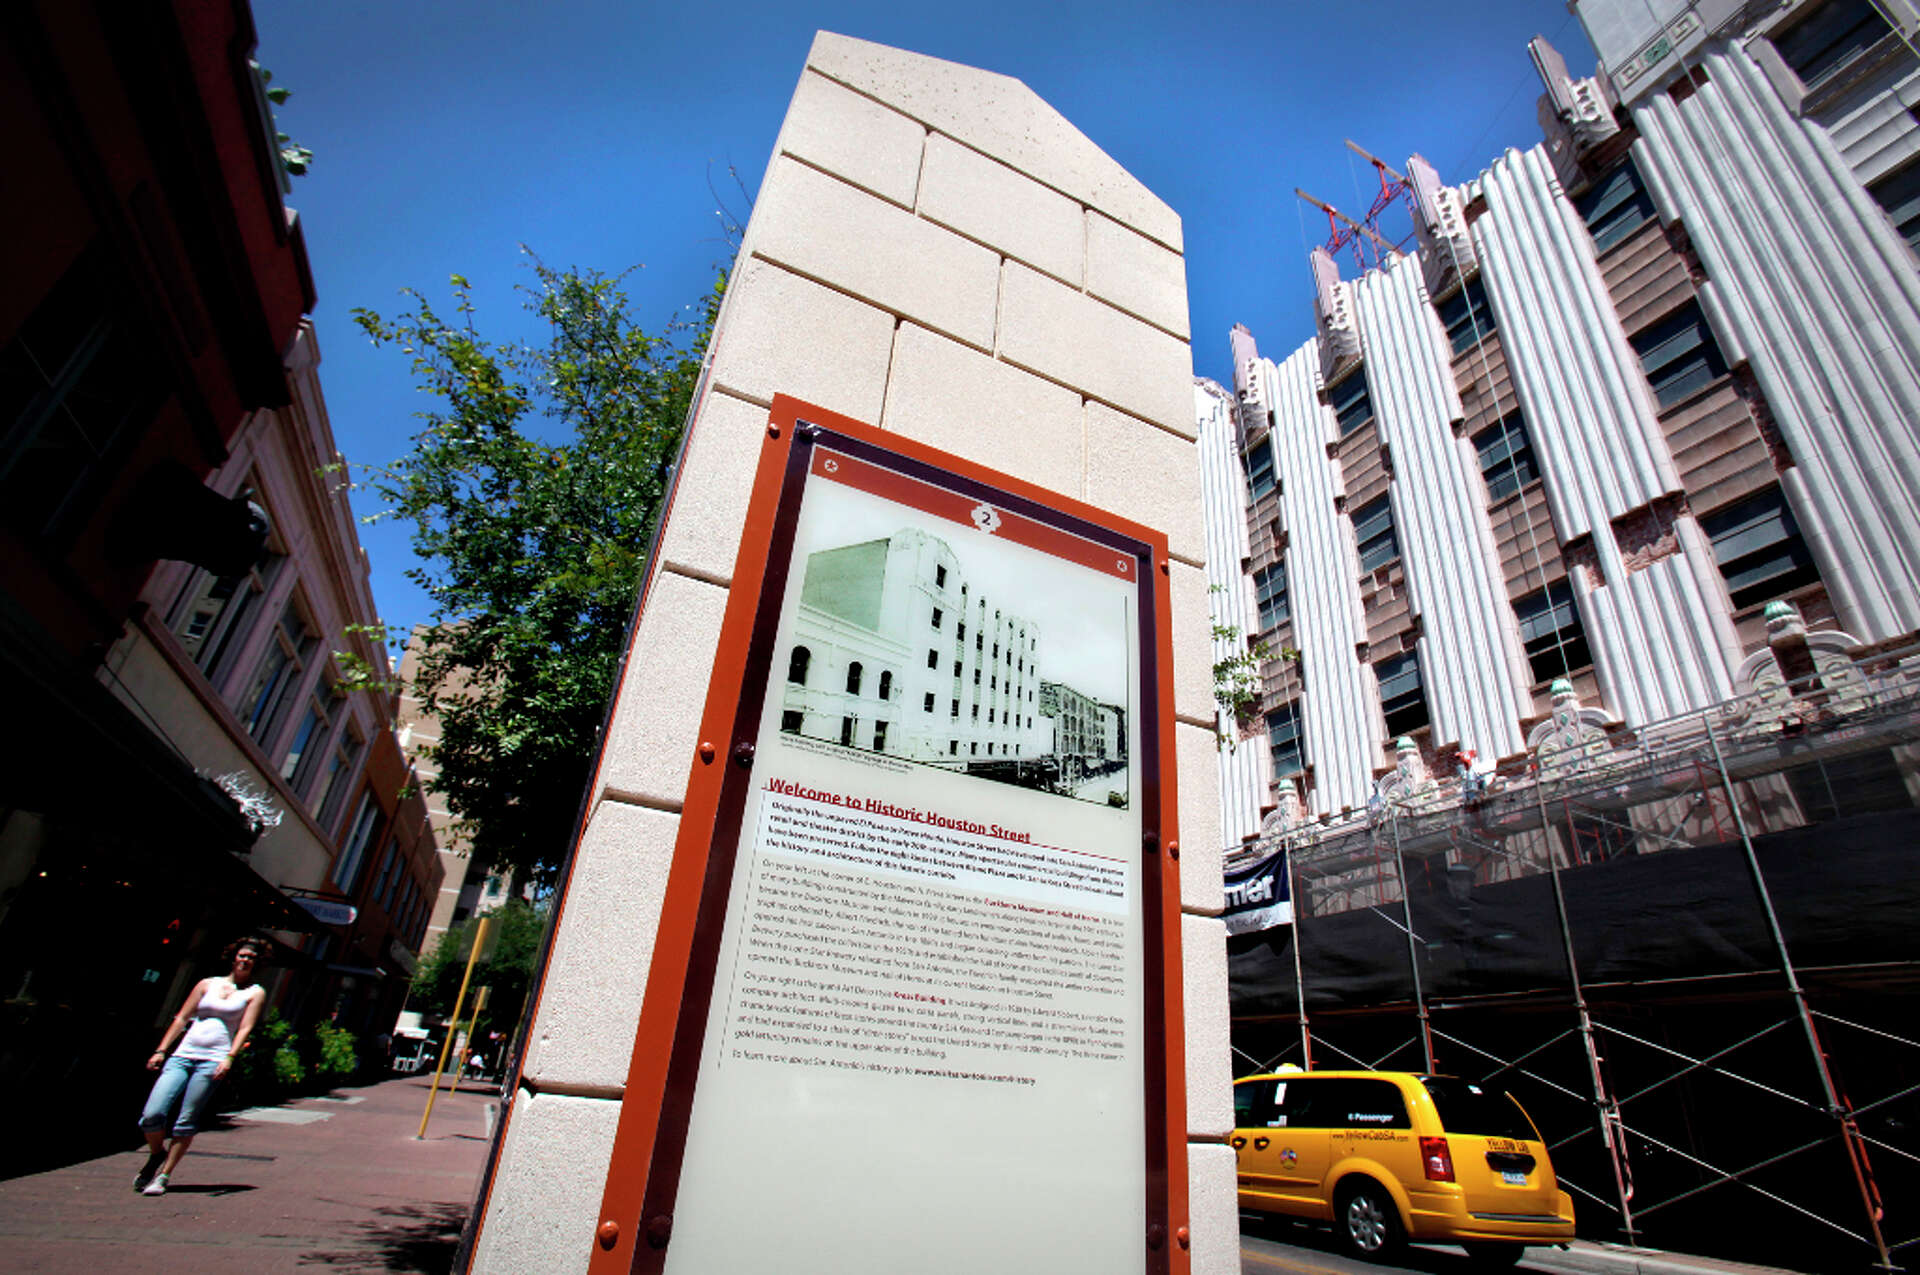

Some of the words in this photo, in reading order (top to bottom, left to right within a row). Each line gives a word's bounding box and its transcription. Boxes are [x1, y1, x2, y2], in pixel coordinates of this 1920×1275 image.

[982, 511, 991, 526] 2
[767, 777, 842, 806] Welcome
[844, 794, 862, 810] to
[864, 797, 924, 822] Historic
[925, 809, 986, 835] Houston
[989, 823, 1031, 844] Street
[1354, 1112, 1394, 1124] Passenger
